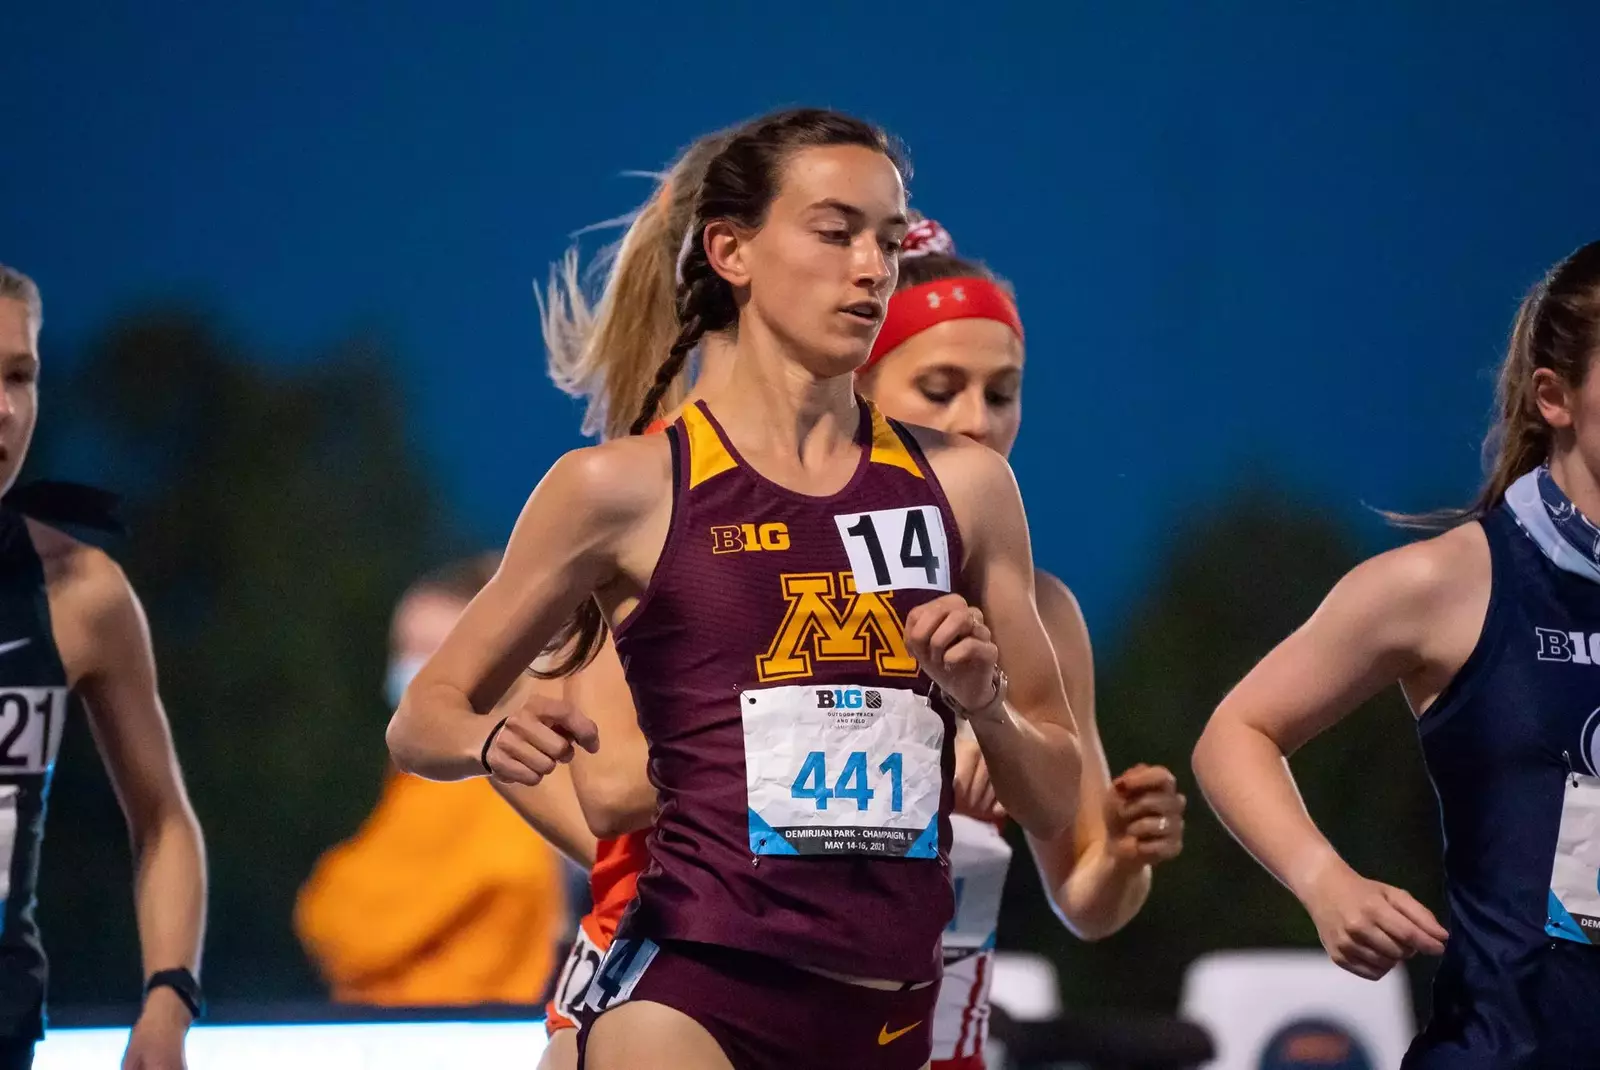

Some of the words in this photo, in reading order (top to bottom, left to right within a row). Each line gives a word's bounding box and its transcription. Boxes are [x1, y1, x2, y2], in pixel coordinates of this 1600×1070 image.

[847, 509, 940, 586] 14
[755, 571, 920, 683] M
[0, 691, 53, 767] 21
[790, 751, 903, 812] 441
[785, 829, 832, 838] DEMIRJIAN
[834, 829, 856, 838] PARK
[862, 830, 906, 840] CHAMPAIGN,
[824, 841, 844, 850] MAY
[870, 842, 885, 851] 2021
